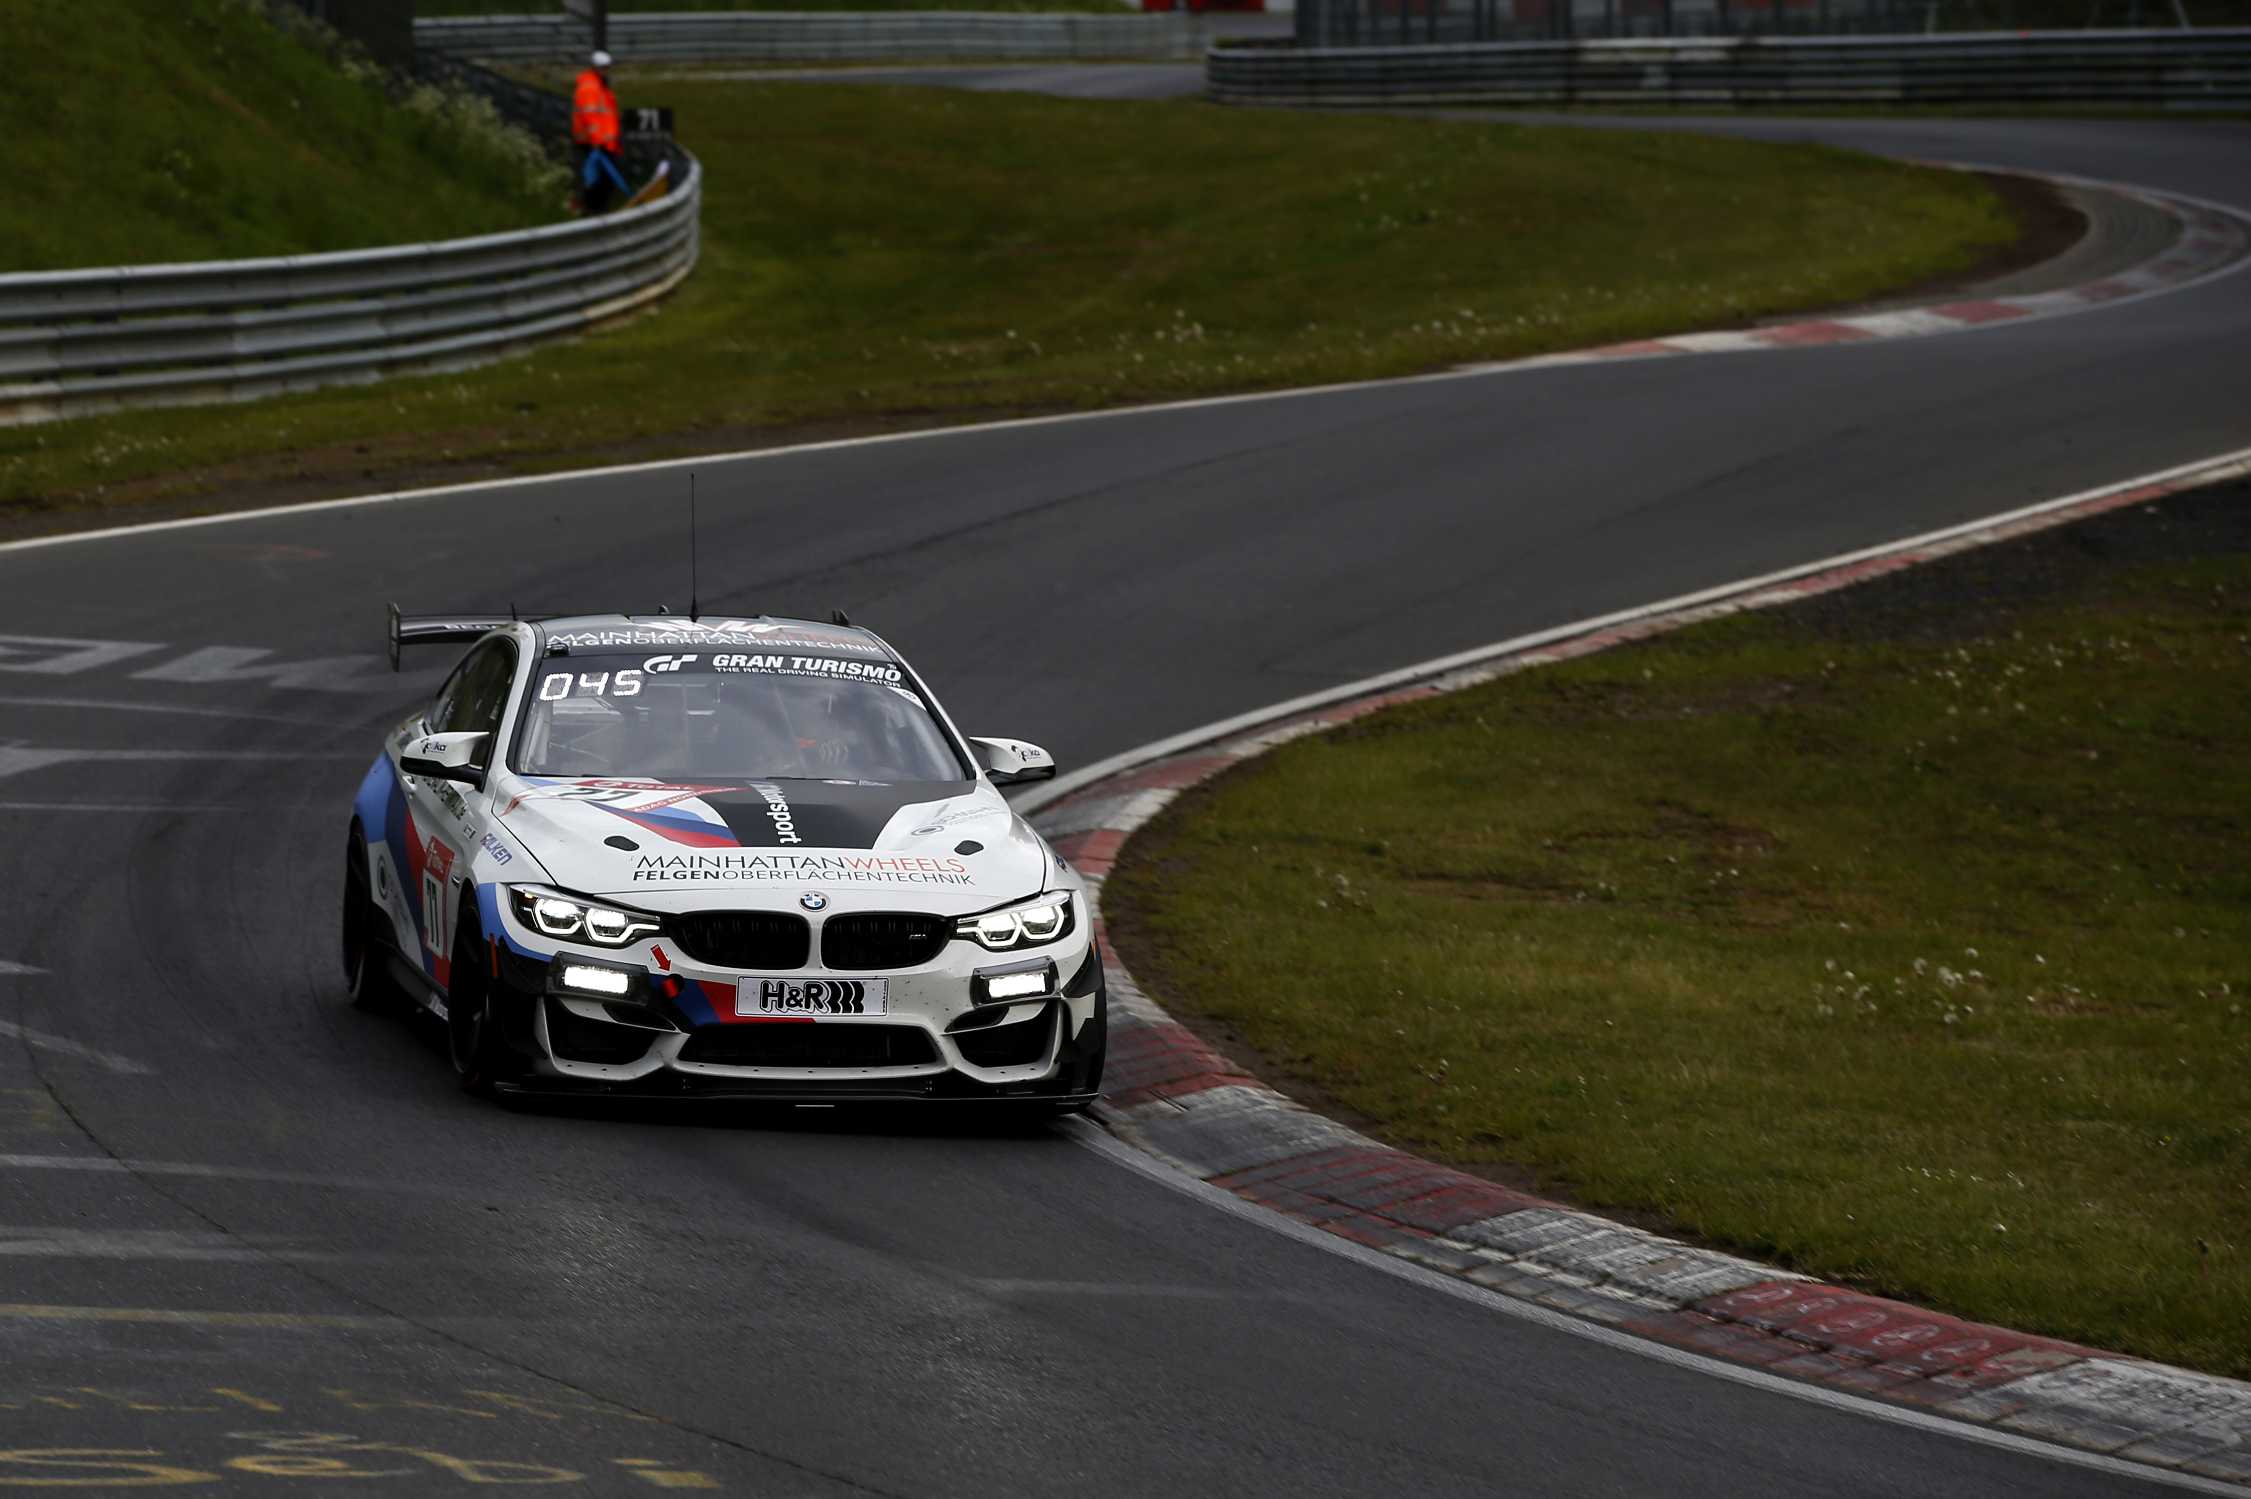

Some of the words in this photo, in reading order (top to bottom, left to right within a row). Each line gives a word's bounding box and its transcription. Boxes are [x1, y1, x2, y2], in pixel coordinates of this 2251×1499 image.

[712, 654, 784, 669] GRAN
[791, 656, 902, 683] TURISMO
[714, 666, 742, 674] THE
[743, 667, 773, 675] REAL
[779, 668, 829, 678] DRIVING
[830, 671, 902, 689] SIMULATOR
[539, 669, 643, 702] 045
[632, 869, 977, 887] FELGENOBERFLÄCHENTECHNIK
[760, 980, 830, 1014] H&R
